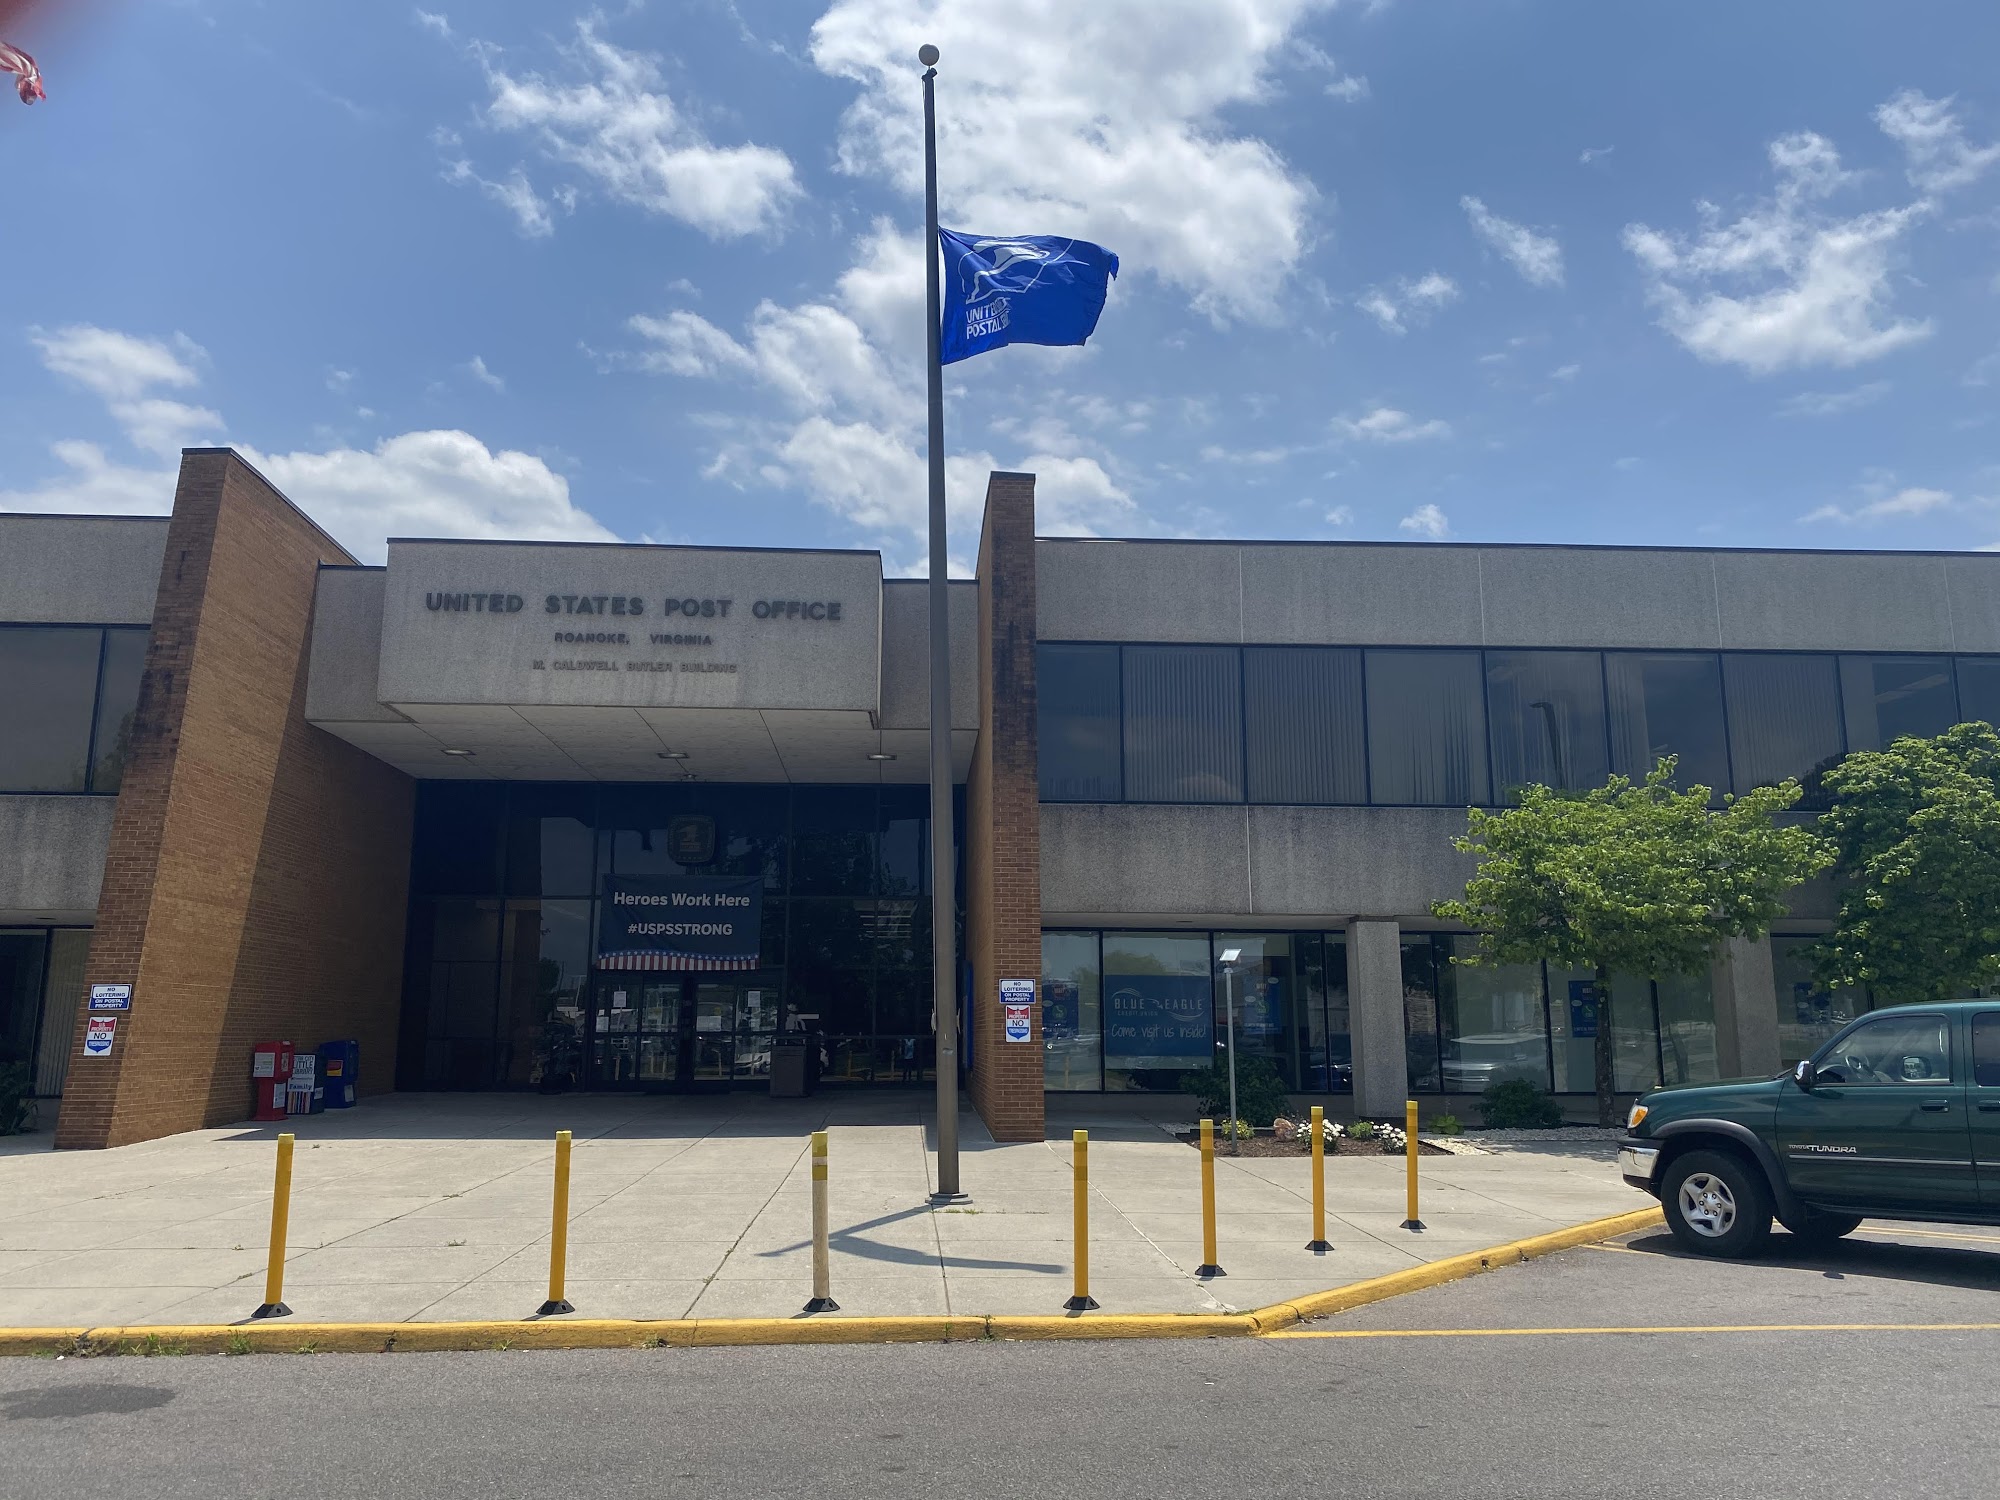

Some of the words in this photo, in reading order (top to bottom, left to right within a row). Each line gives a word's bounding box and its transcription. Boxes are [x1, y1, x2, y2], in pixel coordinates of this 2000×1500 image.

[966, 317, 1001, 340] POSTAL
[426, 592, 524, 613] UNITED
[545, 595, 644, 616] STATES
[664, 598, 732, 617] POST
[752, 600, 841, 621] OFFICE
[554, 632, 630, 645] ROANOKE,
[650, 634, 712, 646] VIRGINIA
[553, 660, 619, 671] CALDWELL
[626, 661, 673, 672] BUTLER
[680, 663, 737, 673] BUILDING
[614, 892, 668, 906] Heroes
[671, 893, 711, 906] Work
[714, 893, 750, 907] Here
[627, 922, 733, 936] #USPSSTRONG
[1114, 998, 1145, 1010] BLUE
[1164, 998, 1203, 1010] EAGLE
[1111, 1023, 1137, 1038] Come
[1141, 1023, 1161, 1038] visit
[1163, 1027, 1176, 1038] us
[1809, 1145, 1857, 1153] TUNDRA
